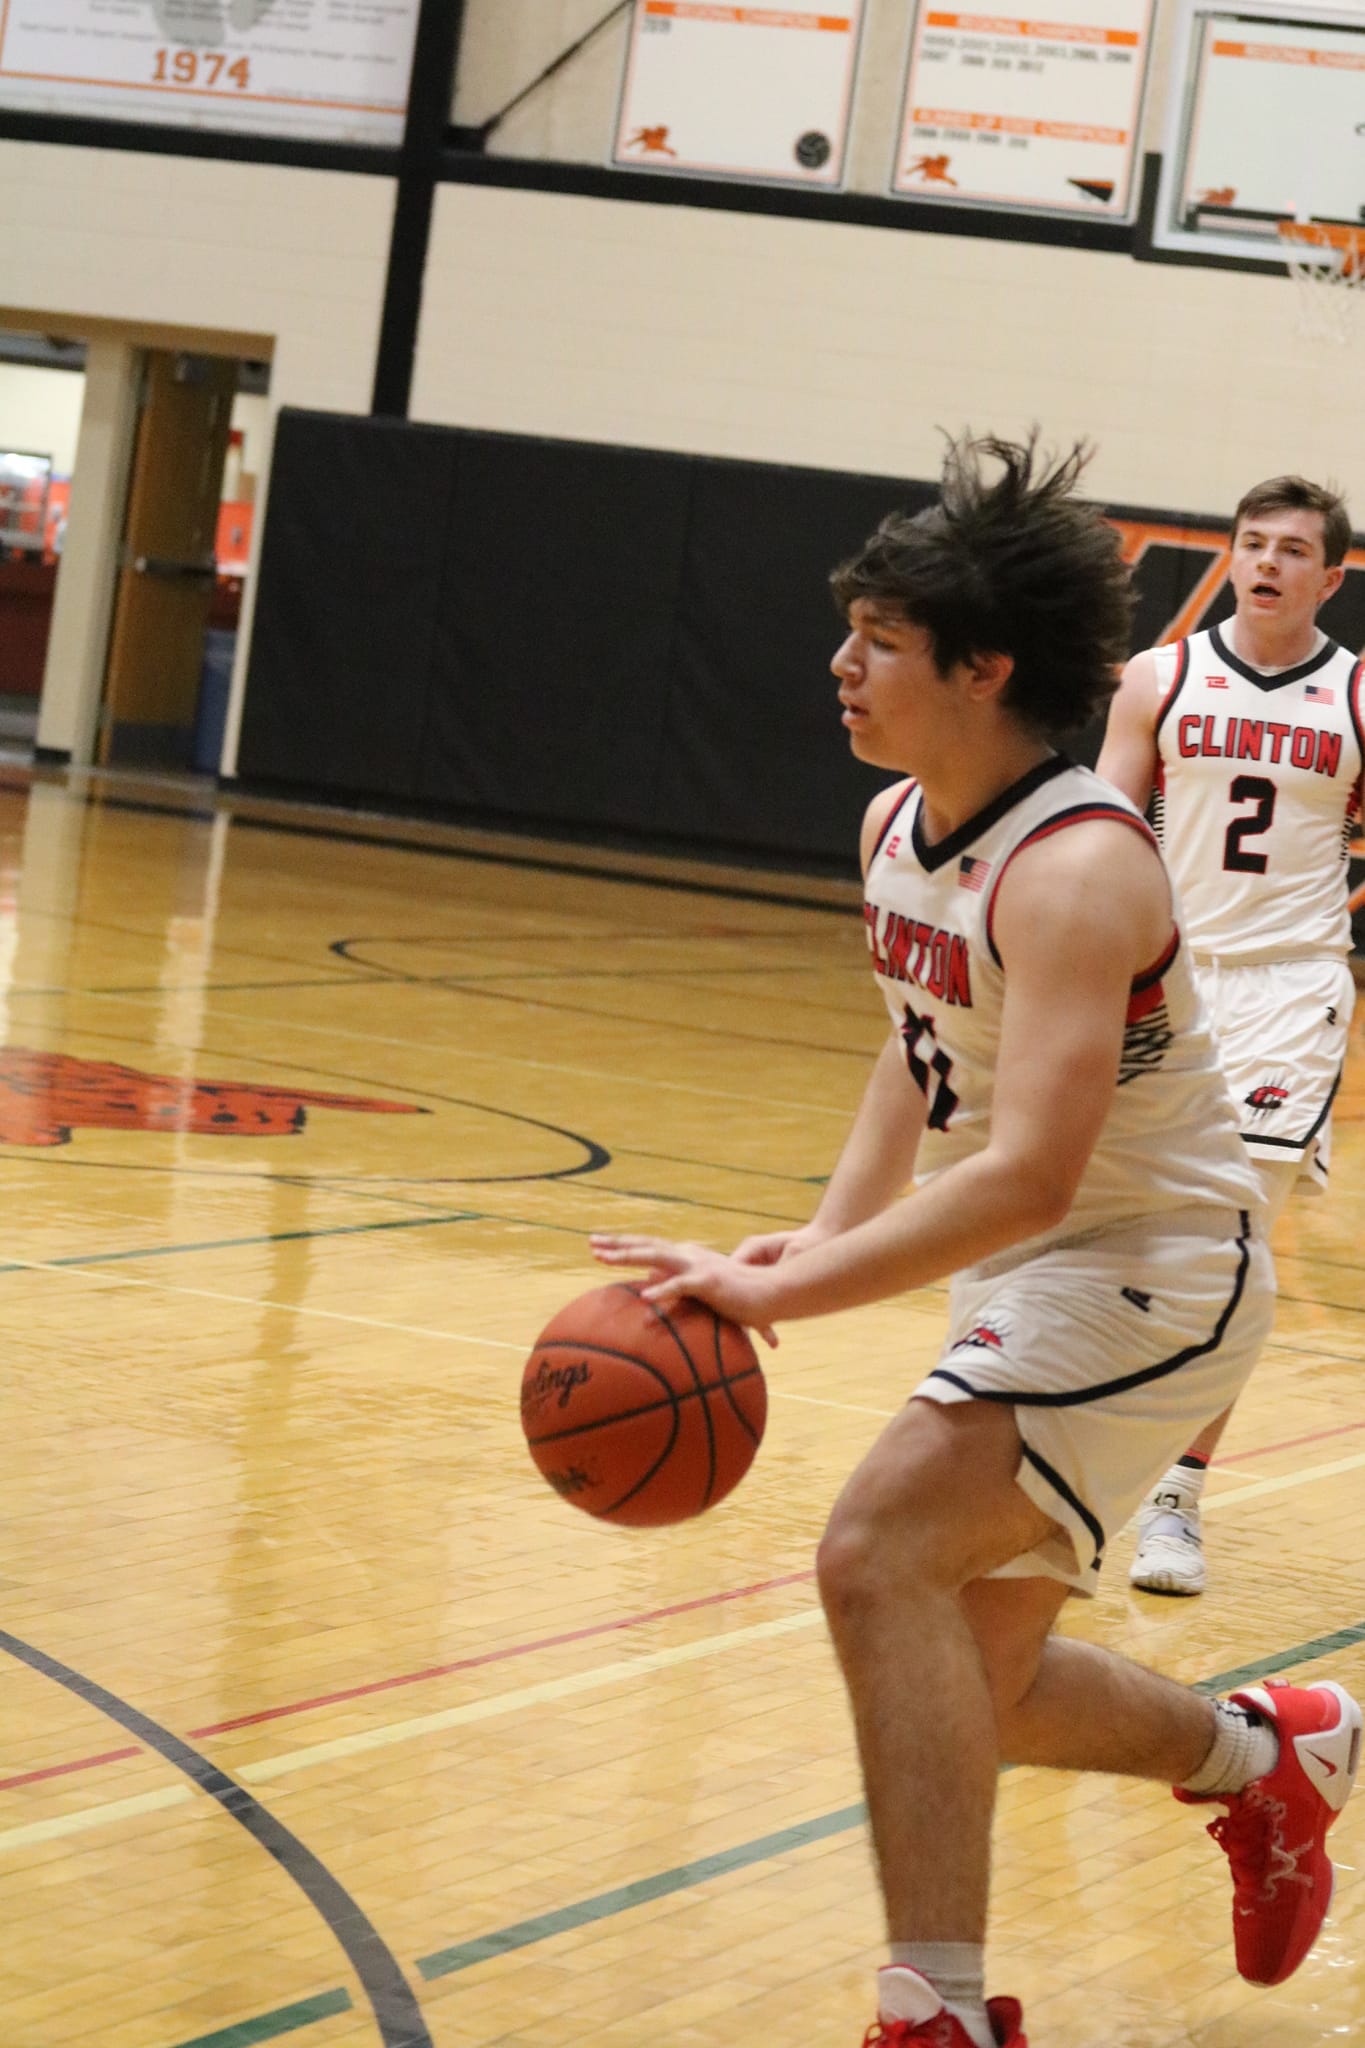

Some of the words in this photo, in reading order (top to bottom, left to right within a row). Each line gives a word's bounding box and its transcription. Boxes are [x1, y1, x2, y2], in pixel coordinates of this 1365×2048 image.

[152, 48, 251, 89] 1974
[1178, 714, 1343, 778] CLINTON
[1222, 774, 1278, 875] 2
